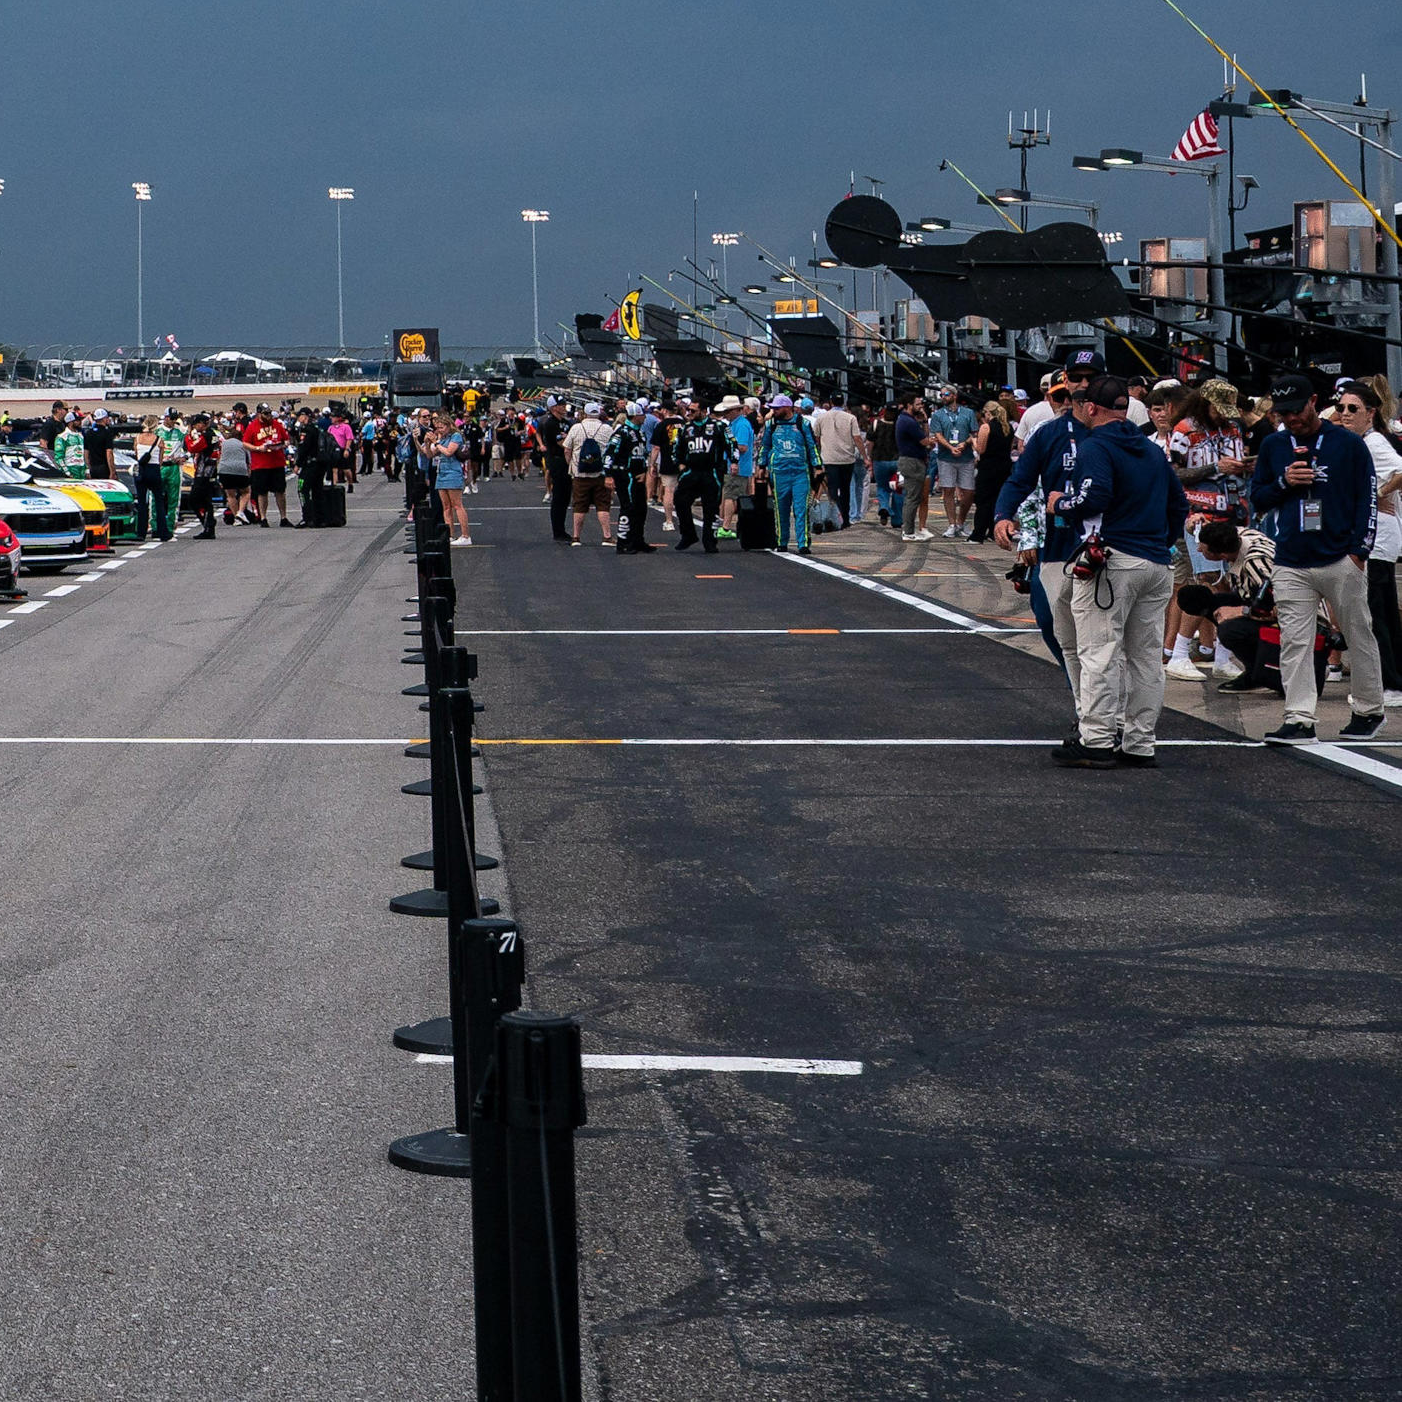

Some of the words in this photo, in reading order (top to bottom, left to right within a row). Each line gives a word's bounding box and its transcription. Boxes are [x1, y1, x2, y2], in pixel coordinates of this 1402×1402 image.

[687, 437, 714, 455] ally
[1216, 494, 1227, 510] 8
[1367, 476, 1377, 530] Fishing
[617, 515, 630, 540] ally
[499, 931, 517, 954] 71
